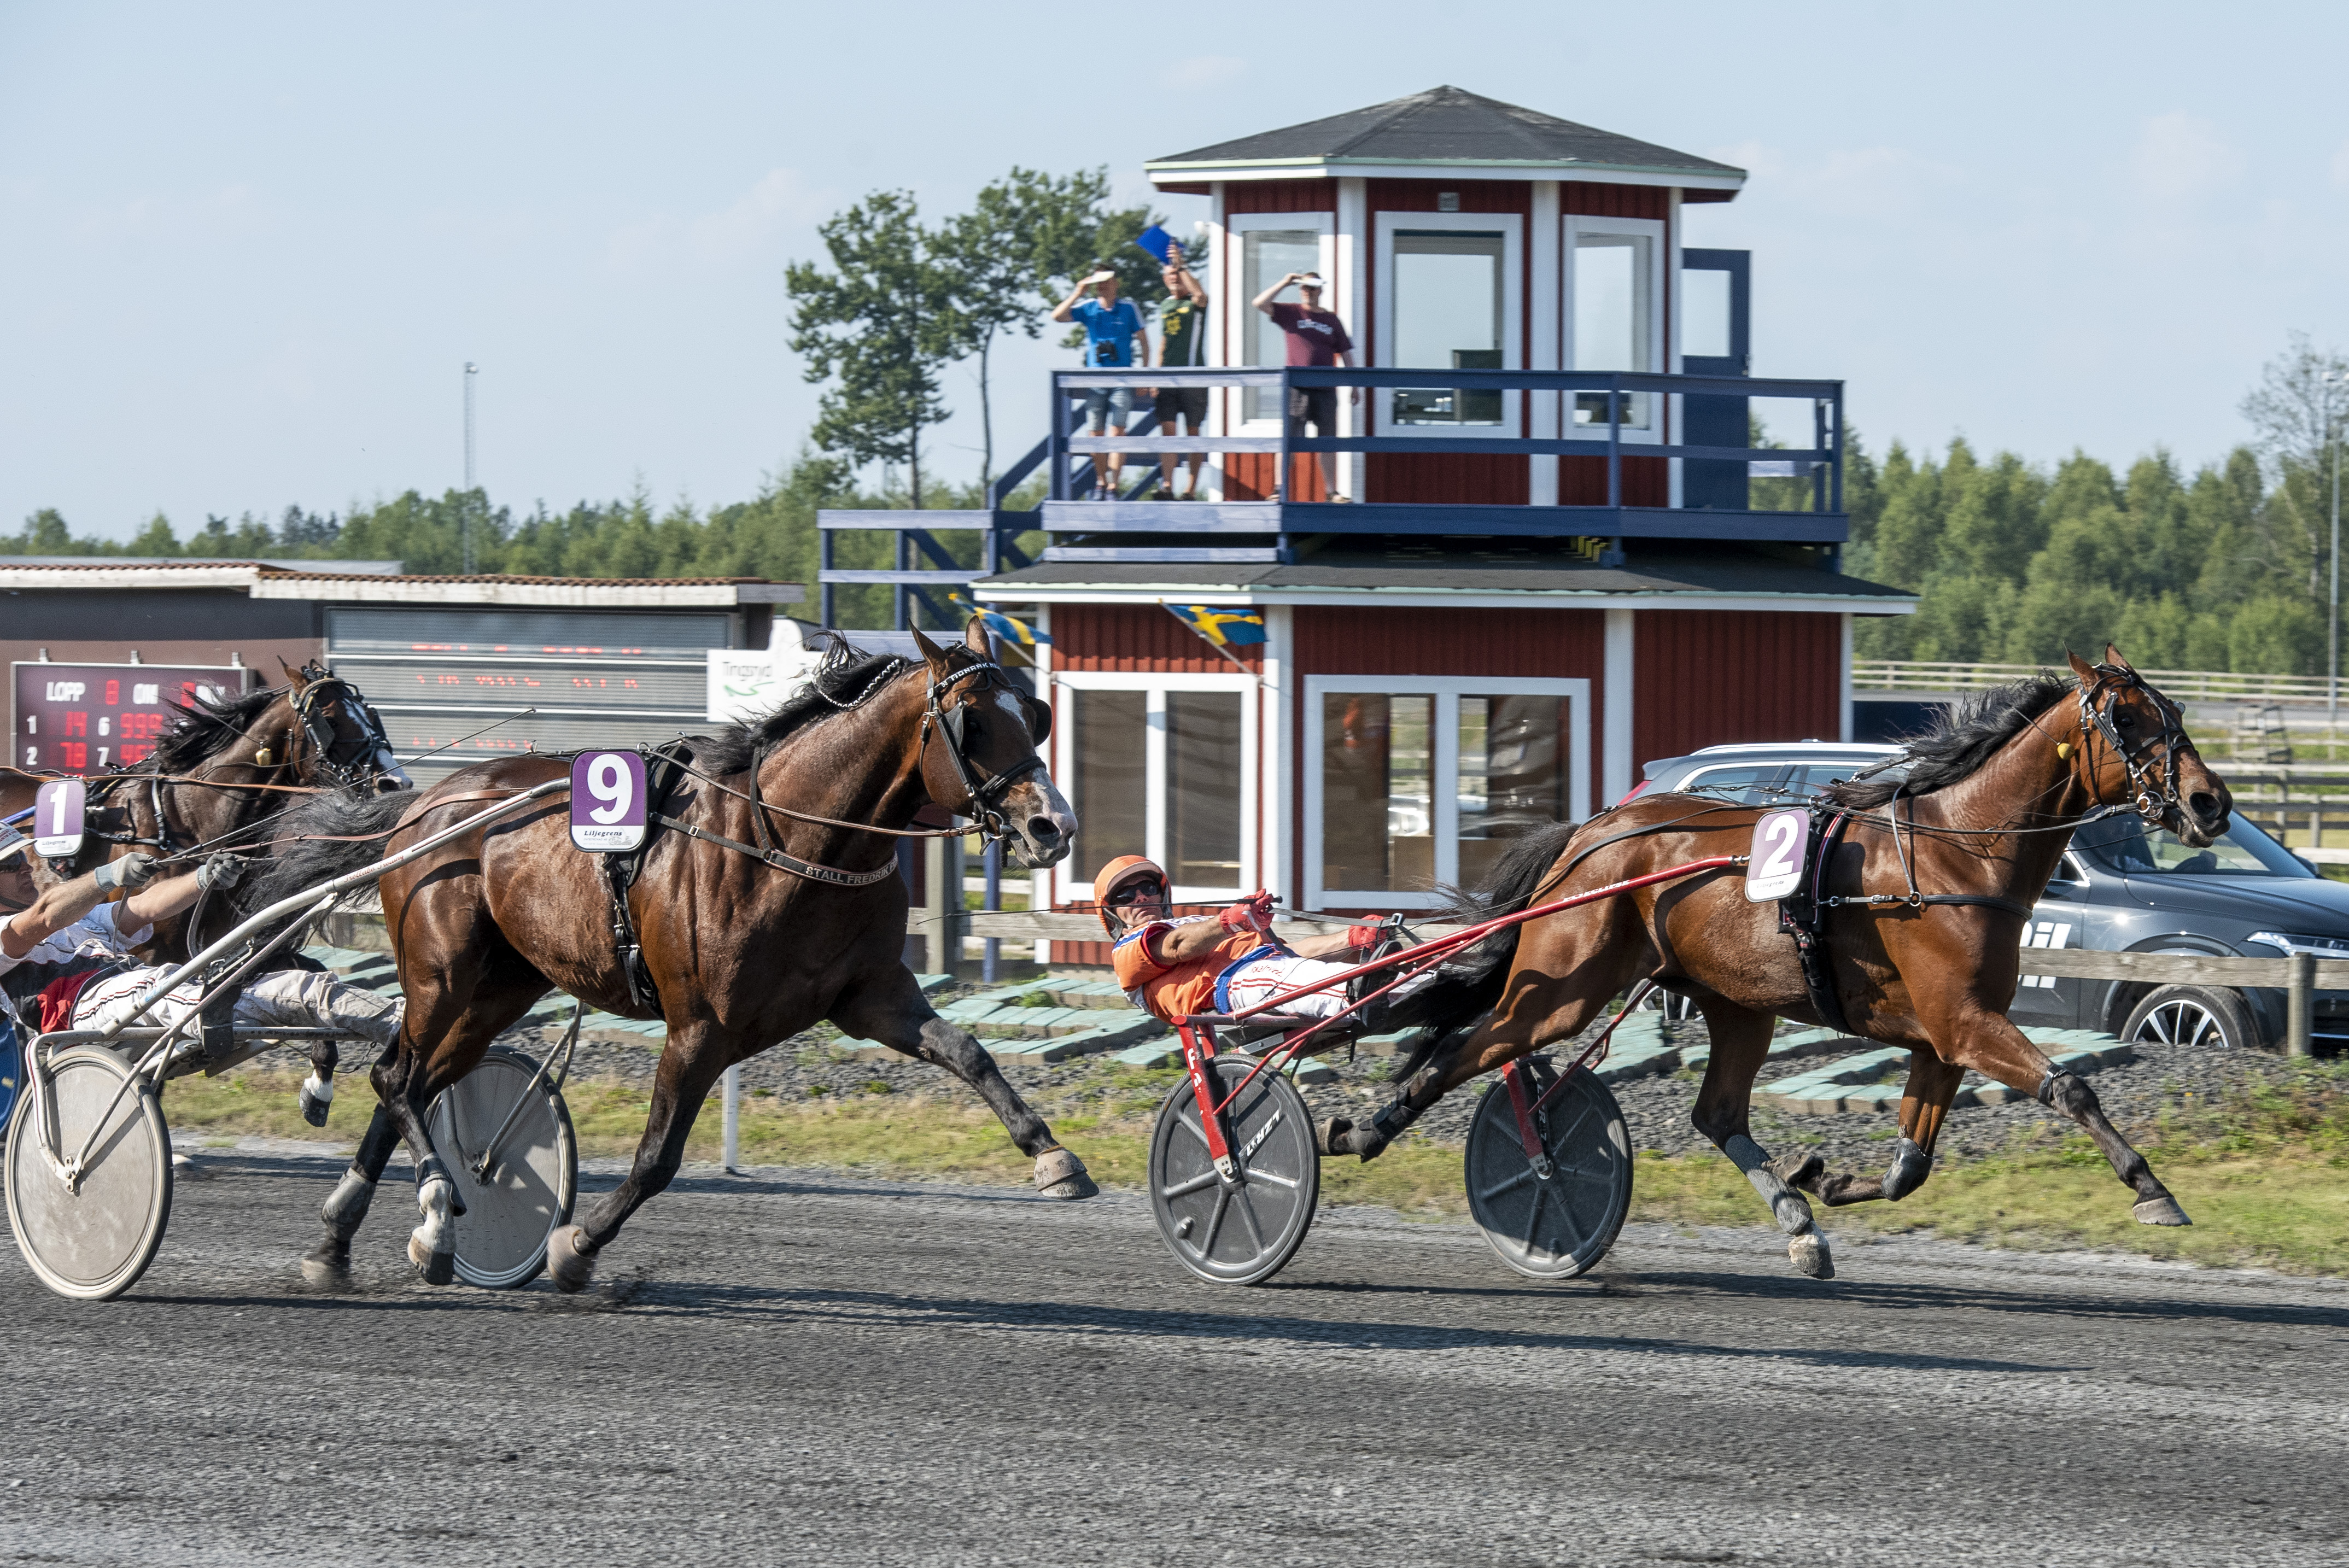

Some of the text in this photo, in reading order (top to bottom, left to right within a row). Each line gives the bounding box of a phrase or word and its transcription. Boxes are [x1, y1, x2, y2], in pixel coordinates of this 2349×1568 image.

[26, 715, 37, 734] 1
[98, 716, 110, 736] 6
[26, 746, 38, 765] 2
[97, 746, 109, 767] 7
[587, 753, 633, 824] 9
[49, 783, 68, 835] 1
[1758, 814, 1799, 879] 2
[805, 866, 889, 884] STALL FREDRIK
